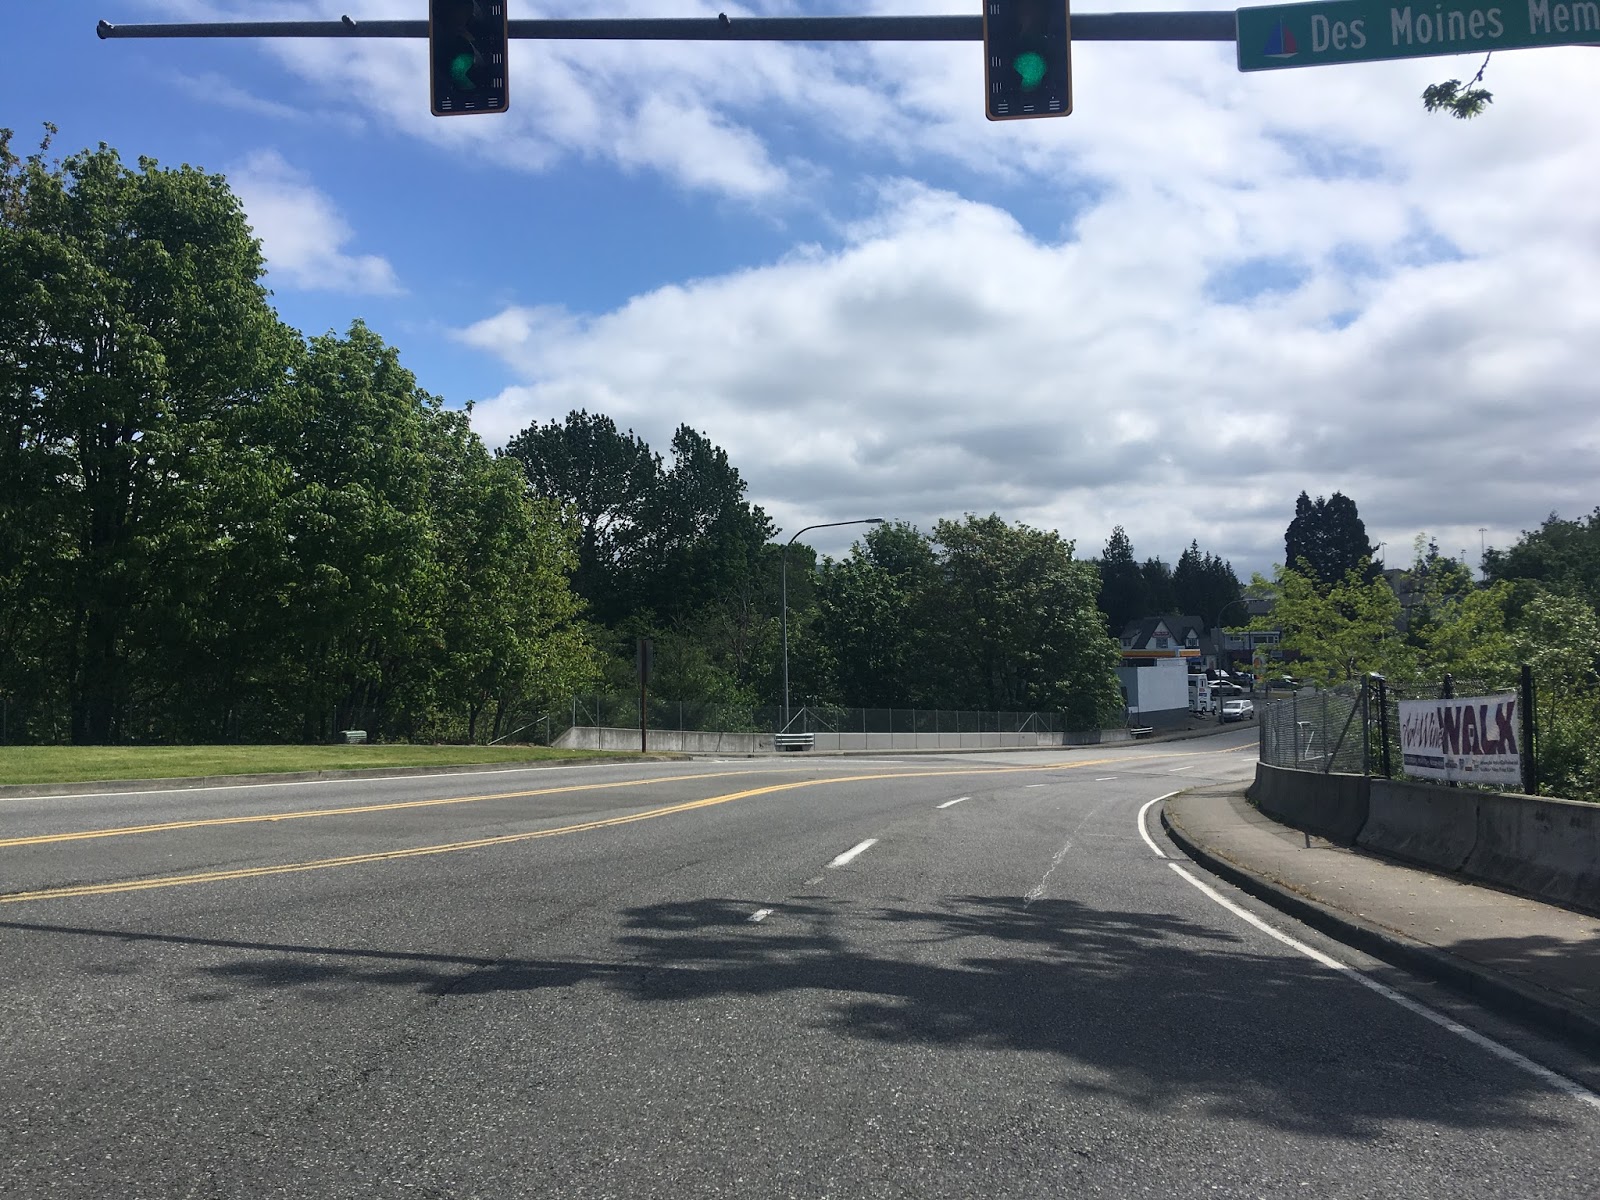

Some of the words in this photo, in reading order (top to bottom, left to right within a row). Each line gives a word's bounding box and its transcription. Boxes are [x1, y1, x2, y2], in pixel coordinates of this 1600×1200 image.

[1310, 14, 1367, 52] Des
[1390, 4, 1504, 46] Moines
[1527, 0, 1600, 34] Mem
[1437, 700, 1518, 755] WALK
